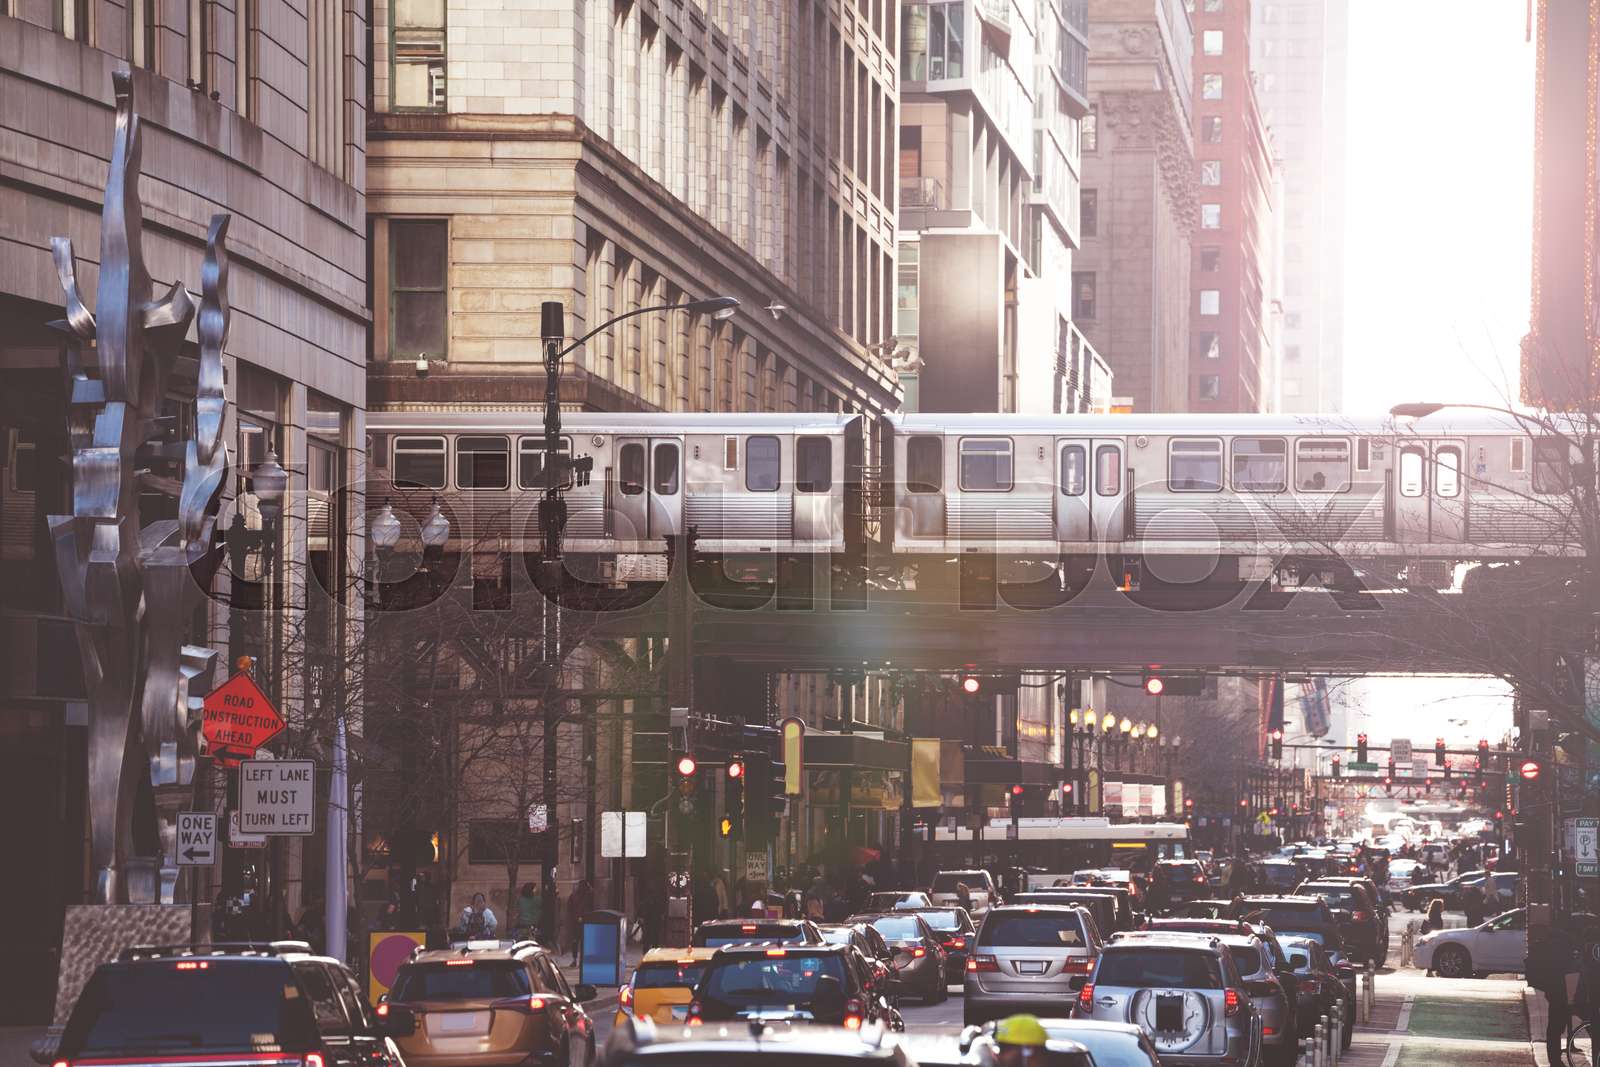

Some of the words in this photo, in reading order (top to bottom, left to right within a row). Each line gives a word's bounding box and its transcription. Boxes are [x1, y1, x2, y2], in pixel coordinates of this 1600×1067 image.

[223, 694, 254, 709] ROAD
[203, 709, 279, 730] ONSTRUCTION
[215, 728, 253, 745] AHEAD
[245, 769, 272, 781] LEFT
[280, 769, 310, 781] LANE
[257, 790, 297, 804] MUST
[182, 817, 212, 829] ONE
[245, 814, 275, 826] TURN
[282, 814, 309, 826] LEFT
[181, 832, 212, 844] WAY
